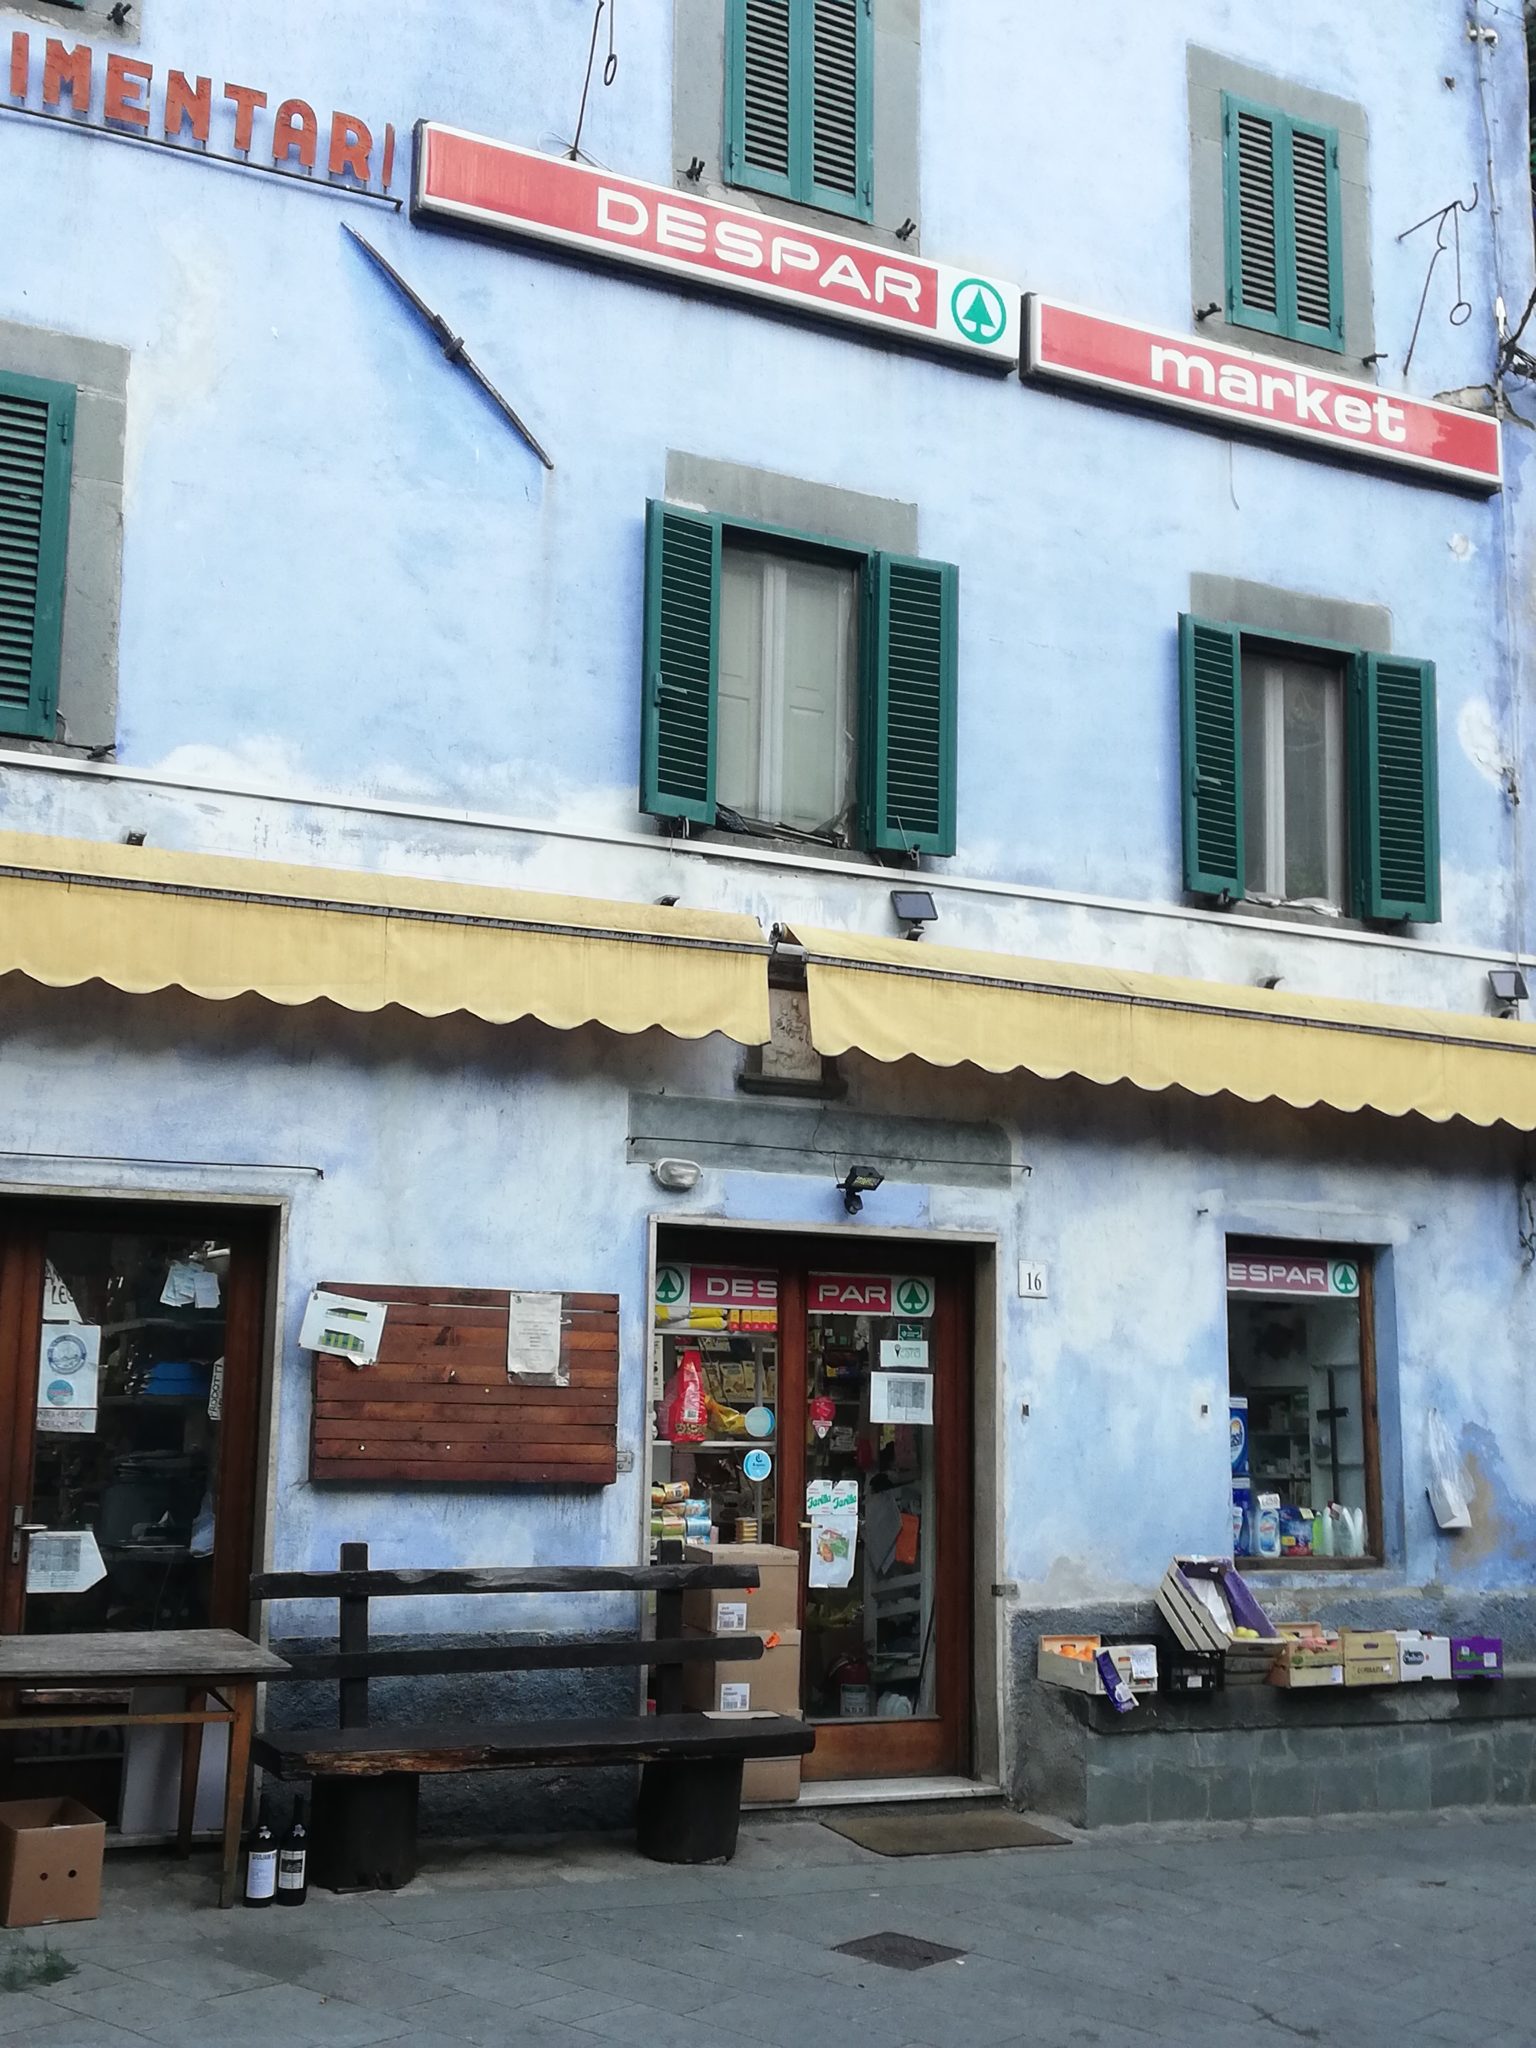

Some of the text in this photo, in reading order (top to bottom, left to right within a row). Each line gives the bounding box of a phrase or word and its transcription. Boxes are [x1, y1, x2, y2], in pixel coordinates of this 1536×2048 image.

[10, 31, 394, 188] IMENTARI
[597, 187, 922, 313] DESPAR
[1151, 345, 1406, 442] market
[707, 1277, 887, 1305] DES PAR
[1027, 1272, 1042, 1291] 16
[1228, 1263, 1325, 1286] ESPAR
